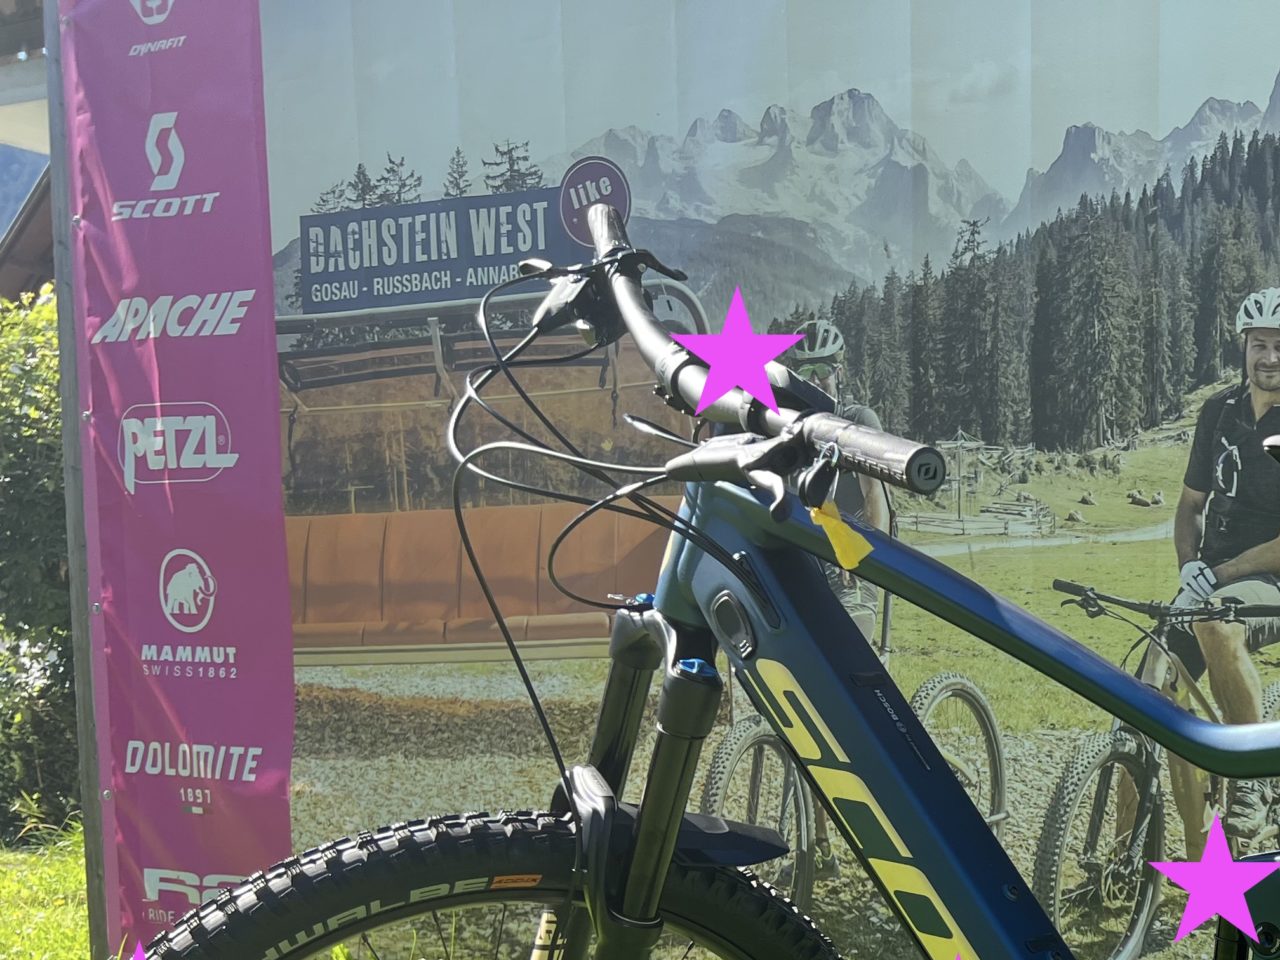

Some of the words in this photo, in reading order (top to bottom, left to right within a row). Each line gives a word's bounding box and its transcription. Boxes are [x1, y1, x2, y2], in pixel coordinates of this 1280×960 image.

[128, 35, 187, 56] DYNAFIT
[111, 192, 220, 221] SCOTT
[569, 173, 613, 210] like
[309, 210, 458, 275] DACHSTEIN
[469, 201, 549, 257] WEST
[311, 280, 358, 302] GOSAU
[373, 270, 451, 296] RUSSBACH
[466, 264, 520, 286] ANNAB
[91, 289, 256, 344] APACHE
[122, 415, 239, 495] PETZL
[141, 644, 237, 663] MAMMUT
[874, 689, 899, 721] BOSCH
[125, 740, 262, 782] DOLOMITE
[179, 787, 211, 804] 1897
